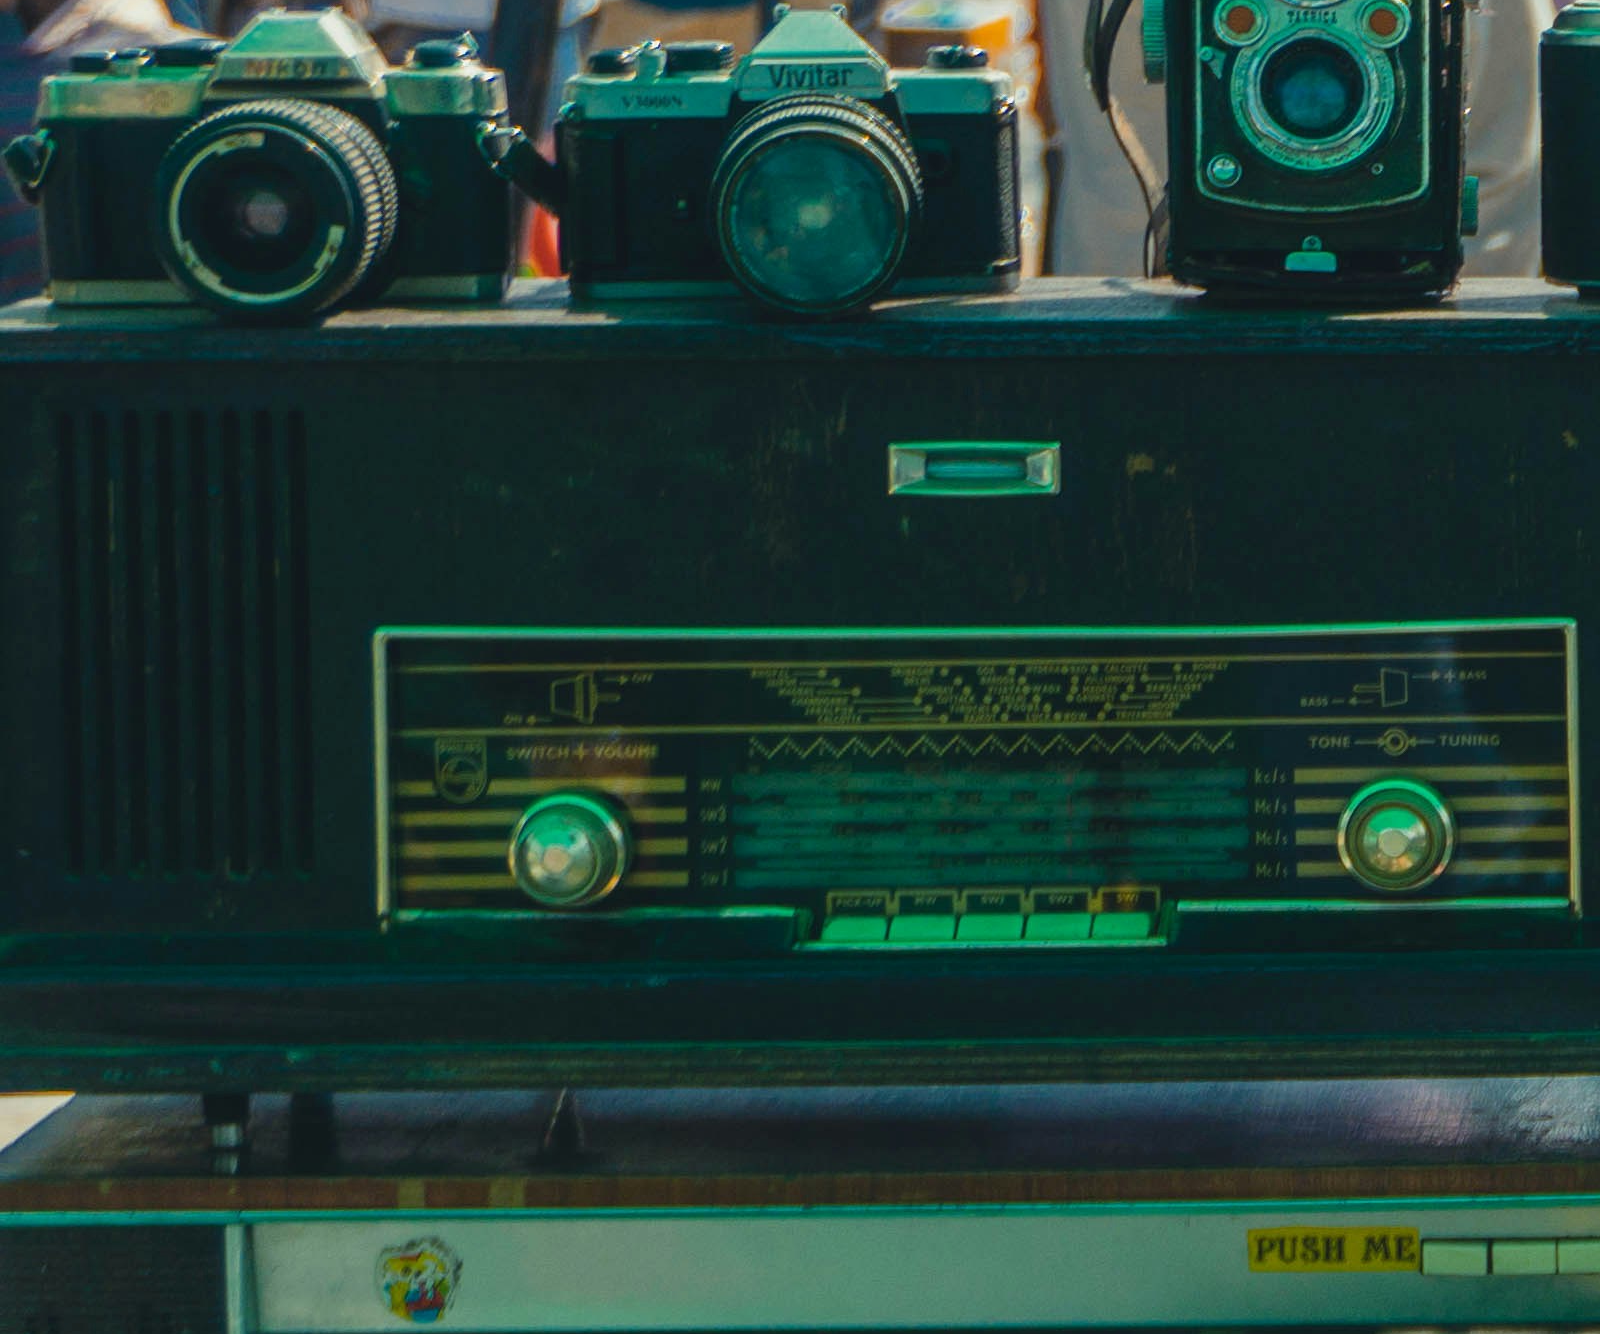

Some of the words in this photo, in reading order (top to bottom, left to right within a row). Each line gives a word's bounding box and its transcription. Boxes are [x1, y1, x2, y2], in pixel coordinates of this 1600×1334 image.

[766, 64, 854, 88] Vivitar
[1458, 669, 1488, 682] BASS
[1300, 696, 1328, 708] BASS
[1308, 735, 1351, 749] TONE
[1439, 733, 1500, 748] TUNING
[505, 746, 571, 761] SWITCH
[594, 742, 659, 759] VOLUME
[1254, 767, 1287, 785] kc/s
[1254, 799, 1288, 816] Mc/s
[1255, 830, 1288, 847] Mc/s
[1255, 861, 1288, 878] Mc/s
[1254, 1234, 1346, 1265] PUSH
[1360, 1233, 1417, 1264] ME
